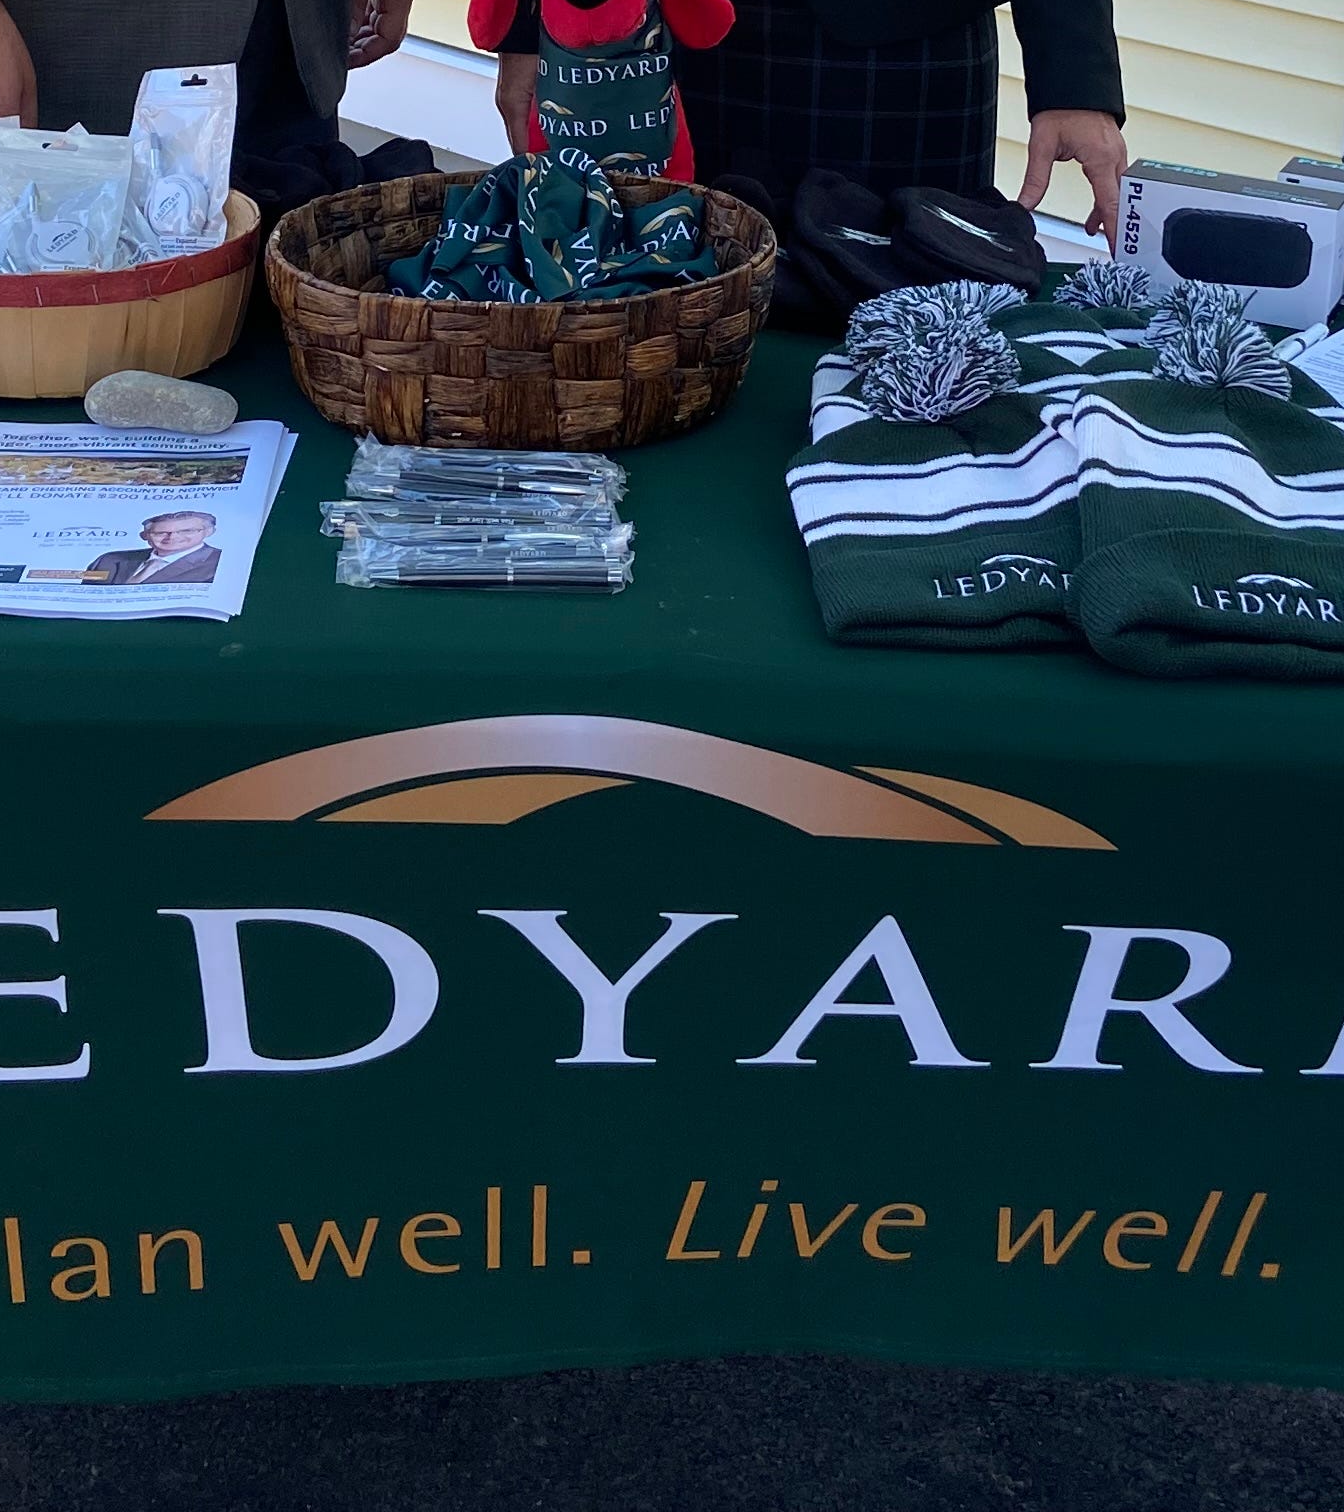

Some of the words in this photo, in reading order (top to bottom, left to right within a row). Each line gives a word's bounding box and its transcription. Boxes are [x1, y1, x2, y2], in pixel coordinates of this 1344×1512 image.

[558, 55, 669, 85] LEDYARD
[1123, 181, 1143, 256] PL-4529
[47, 229, 79, 253] LEDYARD
[2, 433, 73, 442] Together,
[125, 434, 185, 444] building
[83, 441, 137, 449] vibrant
[141, 442, 231, 451] community.
[32, 530, 128, 538] LEDYARD
[279, 1186, 590, 1281] well.
[667, 1180, 926, 1261] Live
[997, 1192, 1280, 1278] well.
